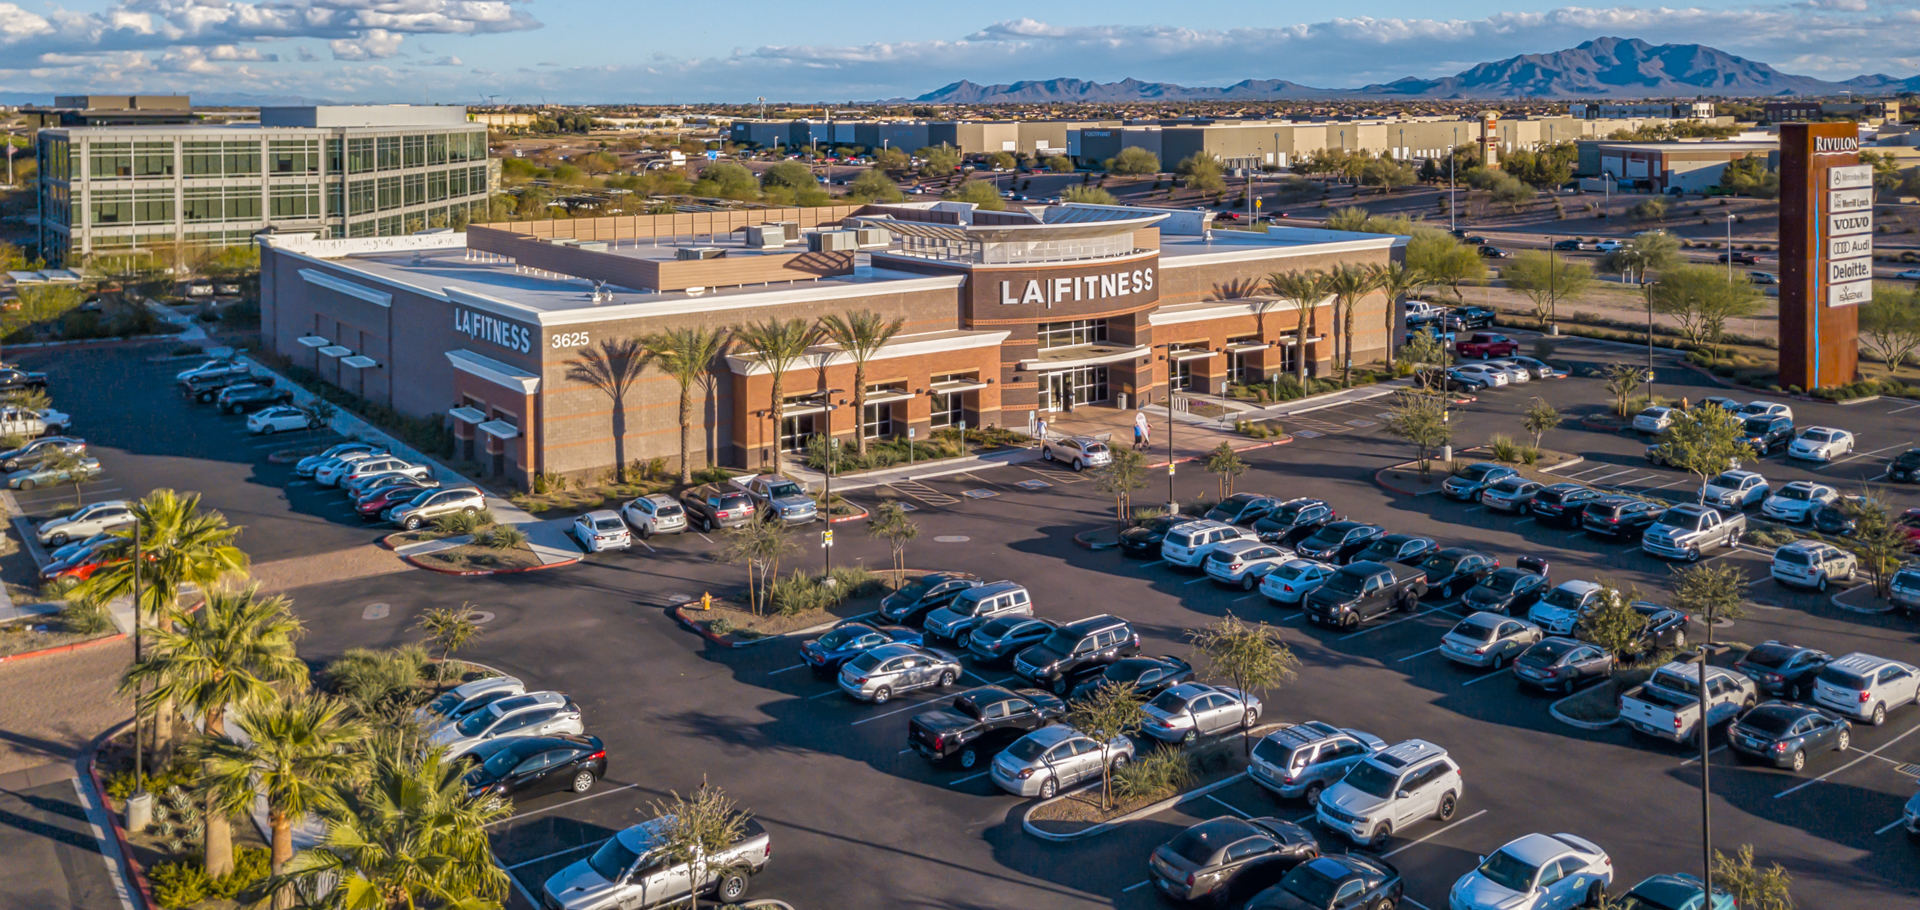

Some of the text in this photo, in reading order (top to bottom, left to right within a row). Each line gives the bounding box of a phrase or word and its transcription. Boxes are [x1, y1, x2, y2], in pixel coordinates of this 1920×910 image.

[1833, 216, 1869, 230] VOLVO
[1852, 240, 1870, 251] Audi
[1054, 267, 1153, 303] FITNESS
[473, 313, 531, 354] FITNESS
[551, 331, 590, 349] 3625
